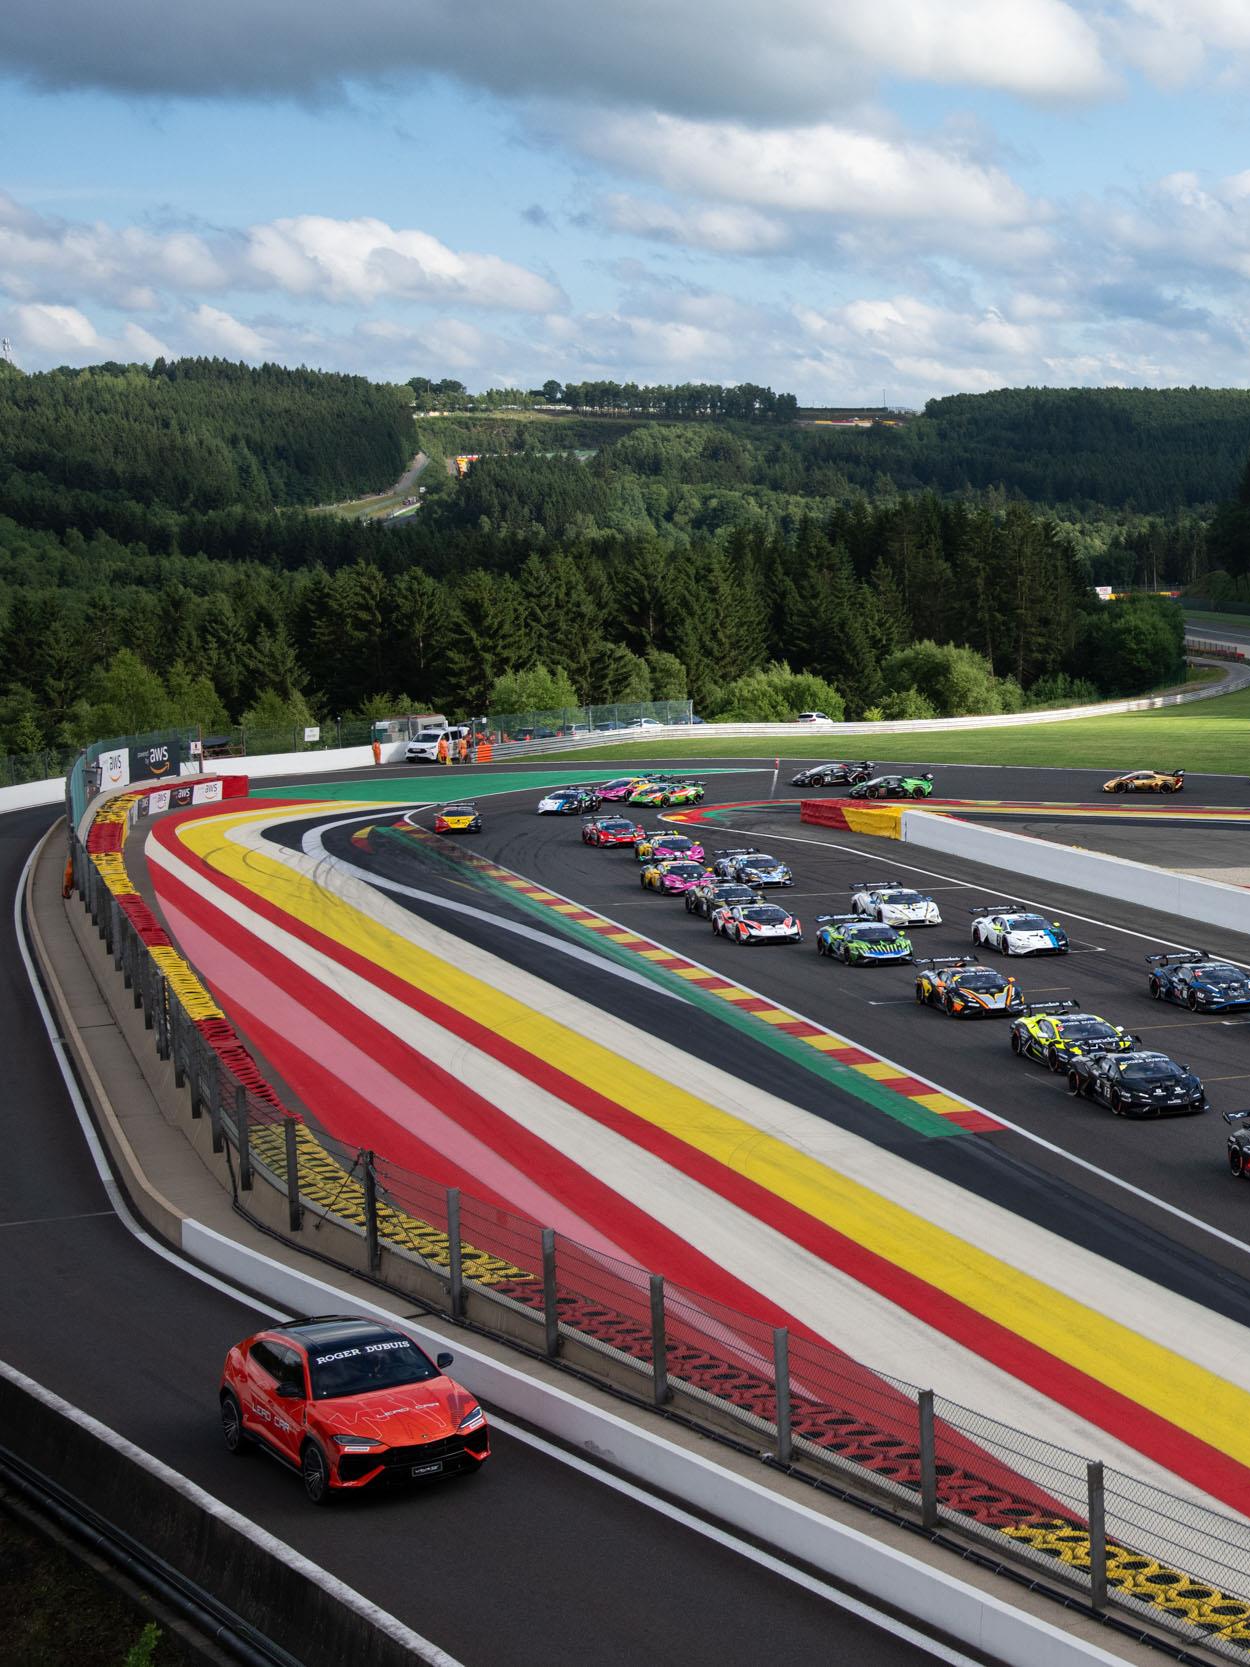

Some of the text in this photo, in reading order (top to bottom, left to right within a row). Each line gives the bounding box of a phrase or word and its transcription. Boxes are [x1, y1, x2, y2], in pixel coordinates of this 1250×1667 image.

[150, 746, 168, 762] aws
[110, 754, 121, 771] aws
[177, 788, 190, 799] aws
[316, 1340, 410, 1365] ROGER DUBUIS
